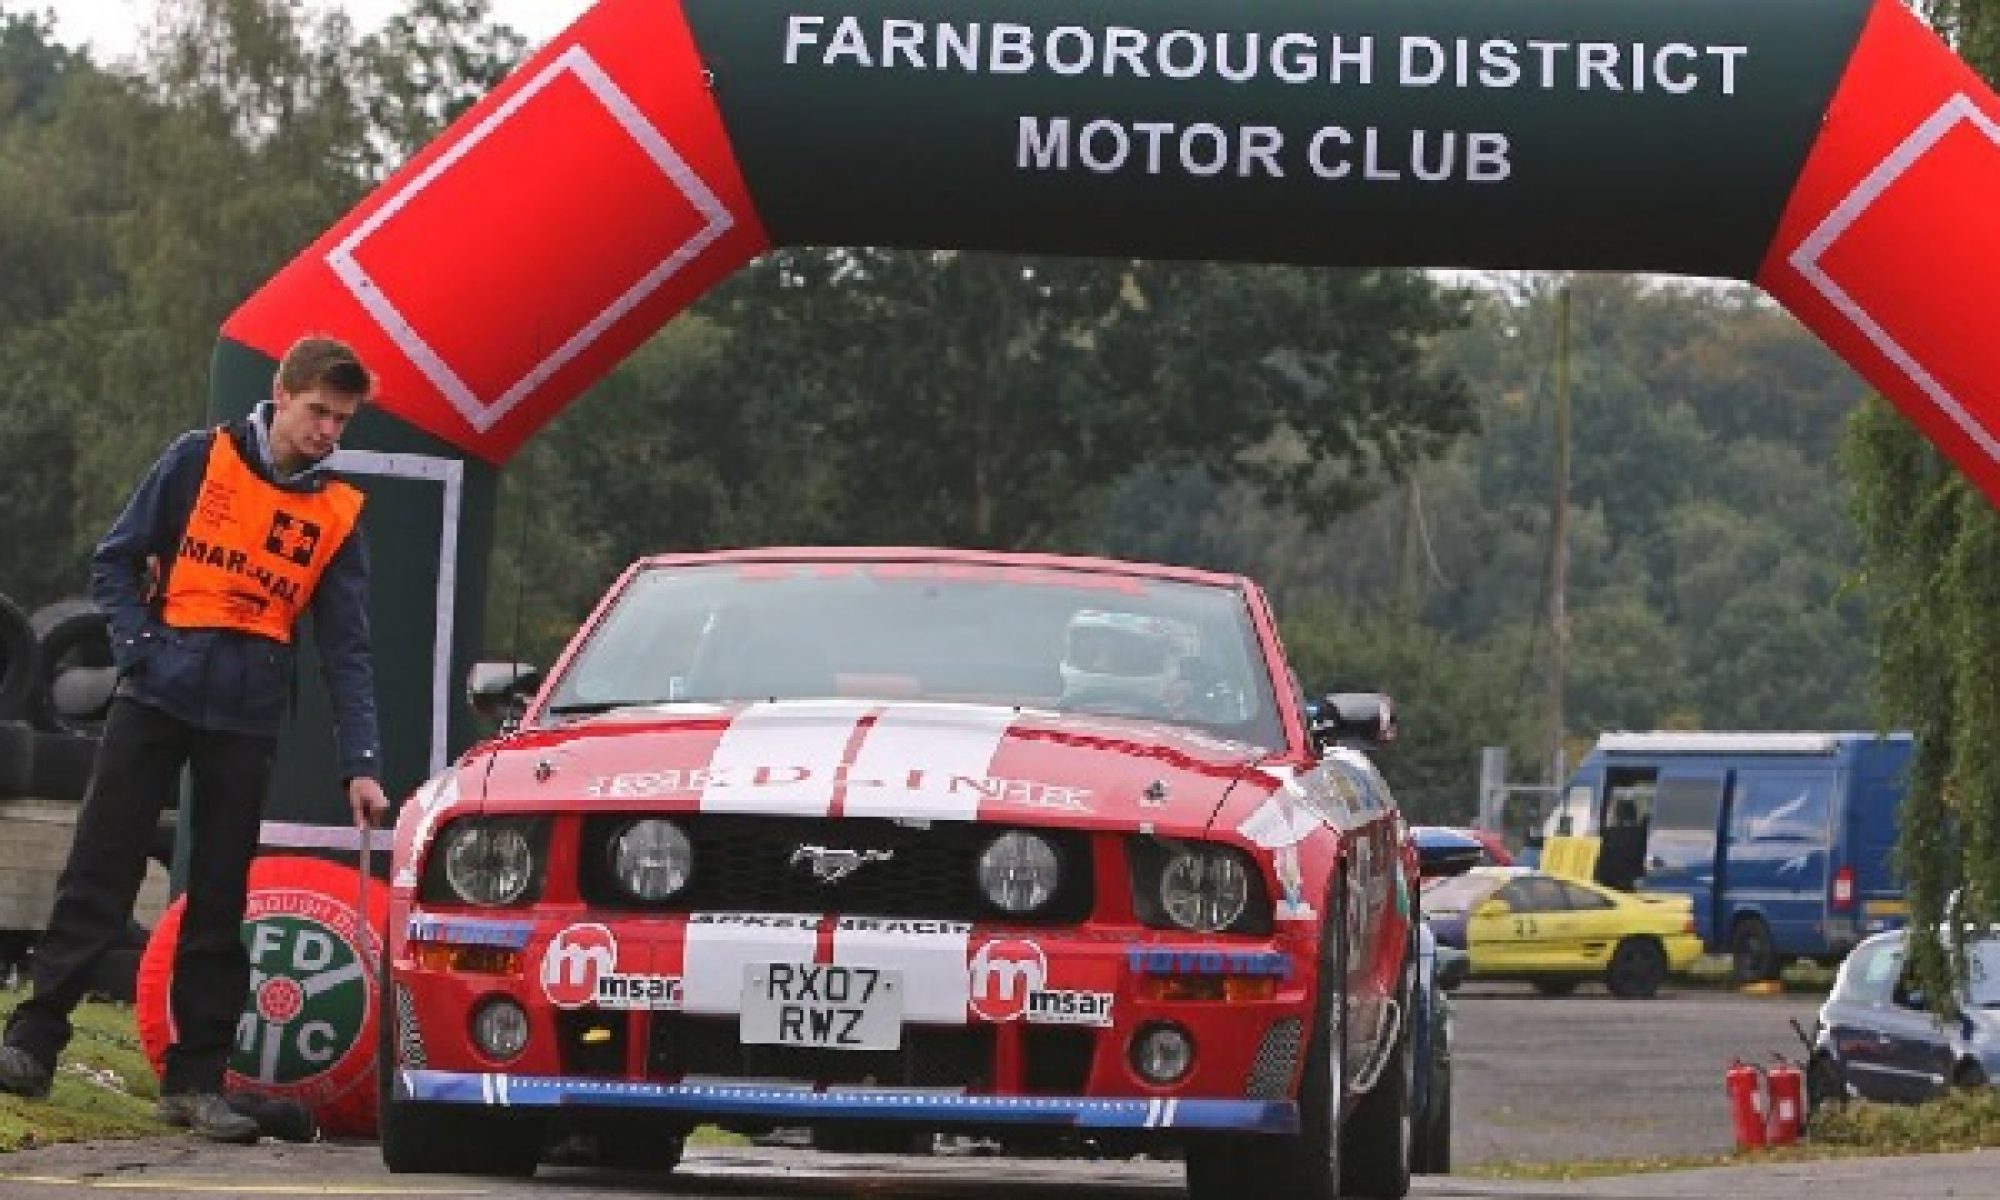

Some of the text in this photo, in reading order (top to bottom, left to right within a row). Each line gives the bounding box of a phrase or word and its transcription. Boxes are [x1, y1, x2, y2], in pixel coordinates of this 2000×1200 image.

[783, 14, 1748, 95] FARNBOROUGH DISTRICT
[1016, 115, 1512, 182] MOTOR CLUB
[598, 975, 682, 1001] msar
[767, 963, 880, 1004] RX07
[1028, 990, 1112, 1016] msar
[779, 1005, 864, 1044] RWZ
